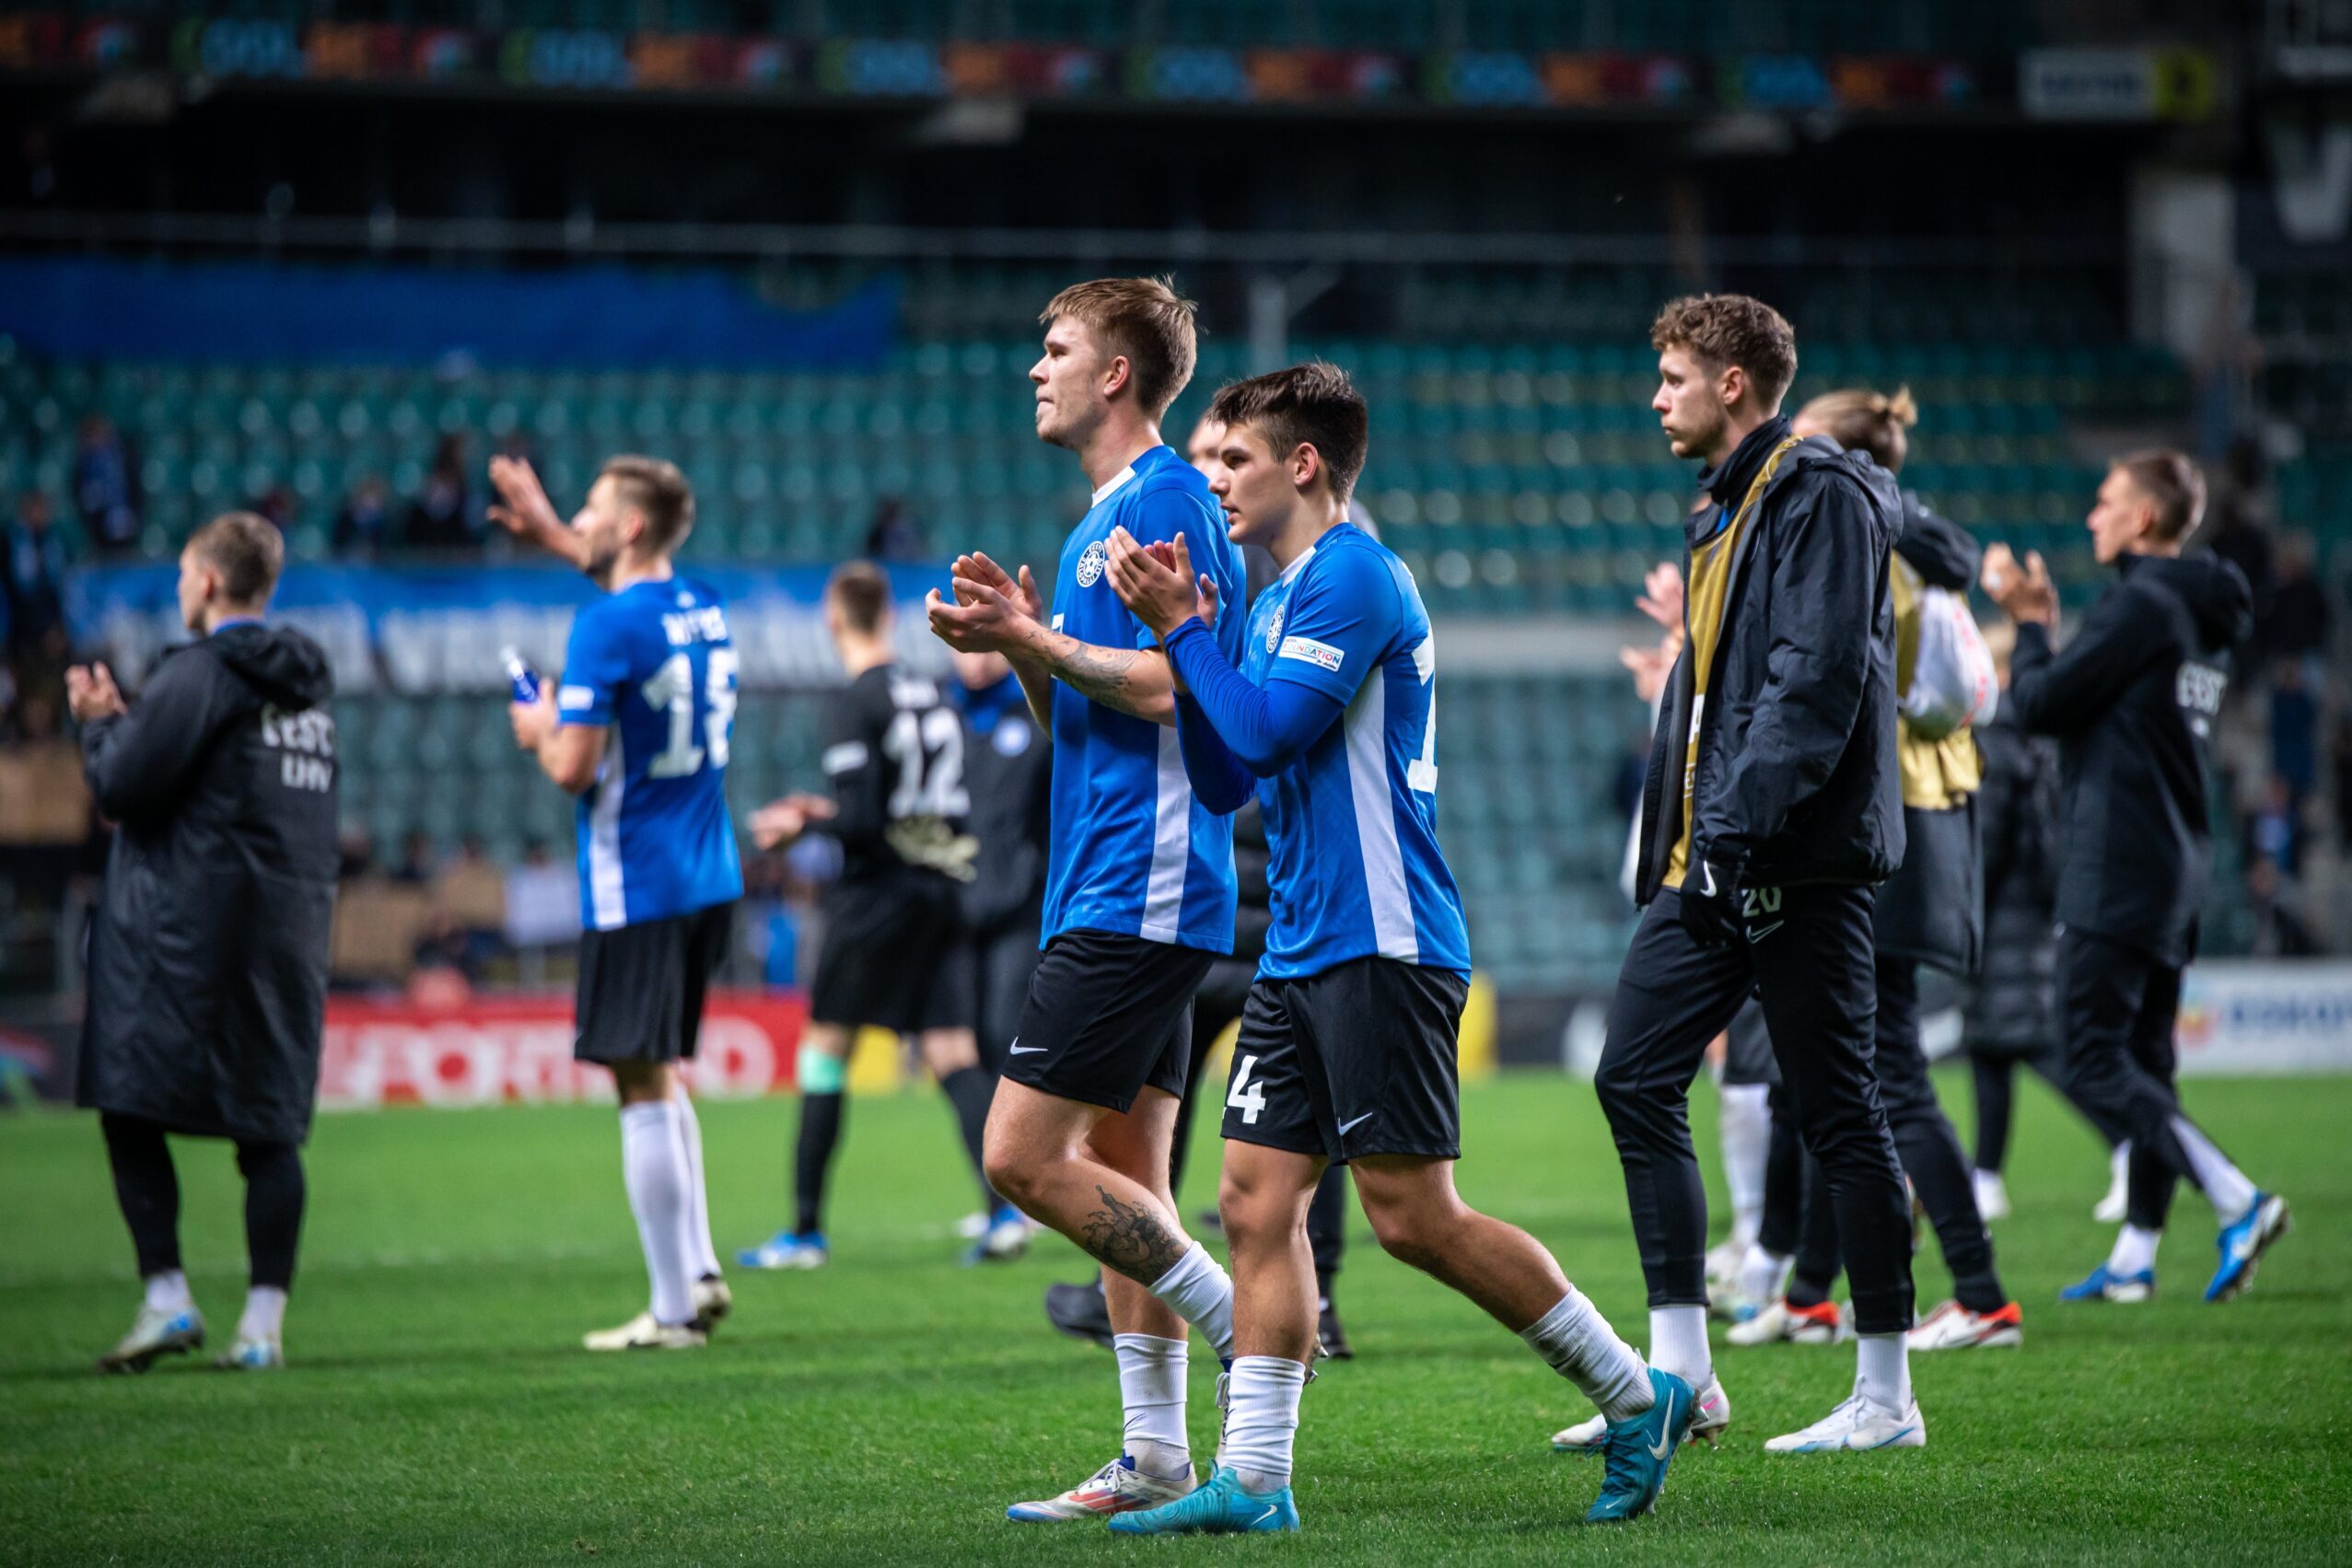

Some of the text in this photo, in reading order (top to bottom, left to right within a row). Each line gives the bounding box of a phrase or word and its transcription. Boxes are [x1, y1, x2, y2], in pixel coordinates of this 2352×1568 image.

[882, 707, 970, 818] 12
[1741, 887, 1782, 917] 20
[1222, 1054, 1266, 1124] 4
